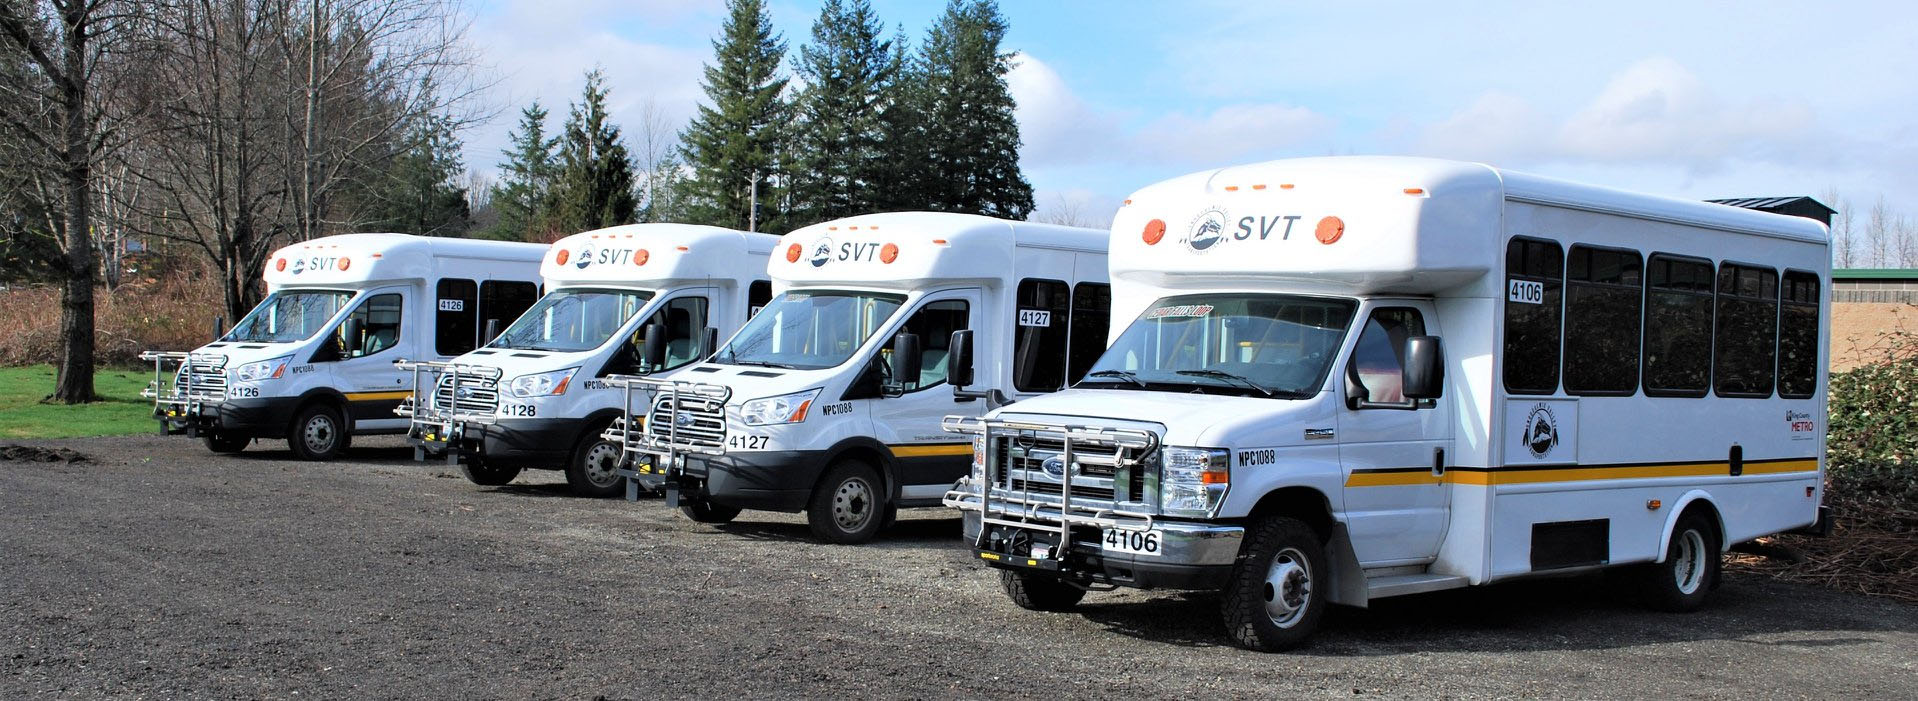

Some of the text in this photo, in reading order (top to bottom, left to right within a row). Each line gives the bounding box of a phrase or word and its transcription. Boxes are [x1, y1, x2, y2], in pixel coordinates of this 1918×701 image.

[1234, 215, 1301, 240] SVT
[598, 248, 632, 265] SVT
[838, 242, 880, 262] SVT
[310, 256, 337, 271] SVT
[1511, 282, 1541, 302] 4106
[440, 300, 462, 310] 4126
[1021, 311, 1049, 325] 4127
[292, 364, 315, 374] NPC1088
[231, 387, 259, 397] 4126
[502, 404, 536, 417] 4128
[822, 401, 853, 416] NPC1088
[1791, 421, 1813, 431] METRO
[729, 435, 769, 449] 4127
[1238, 449, 1276, 467] NPC1088
[1106, 529, 1158, 553] 4106
